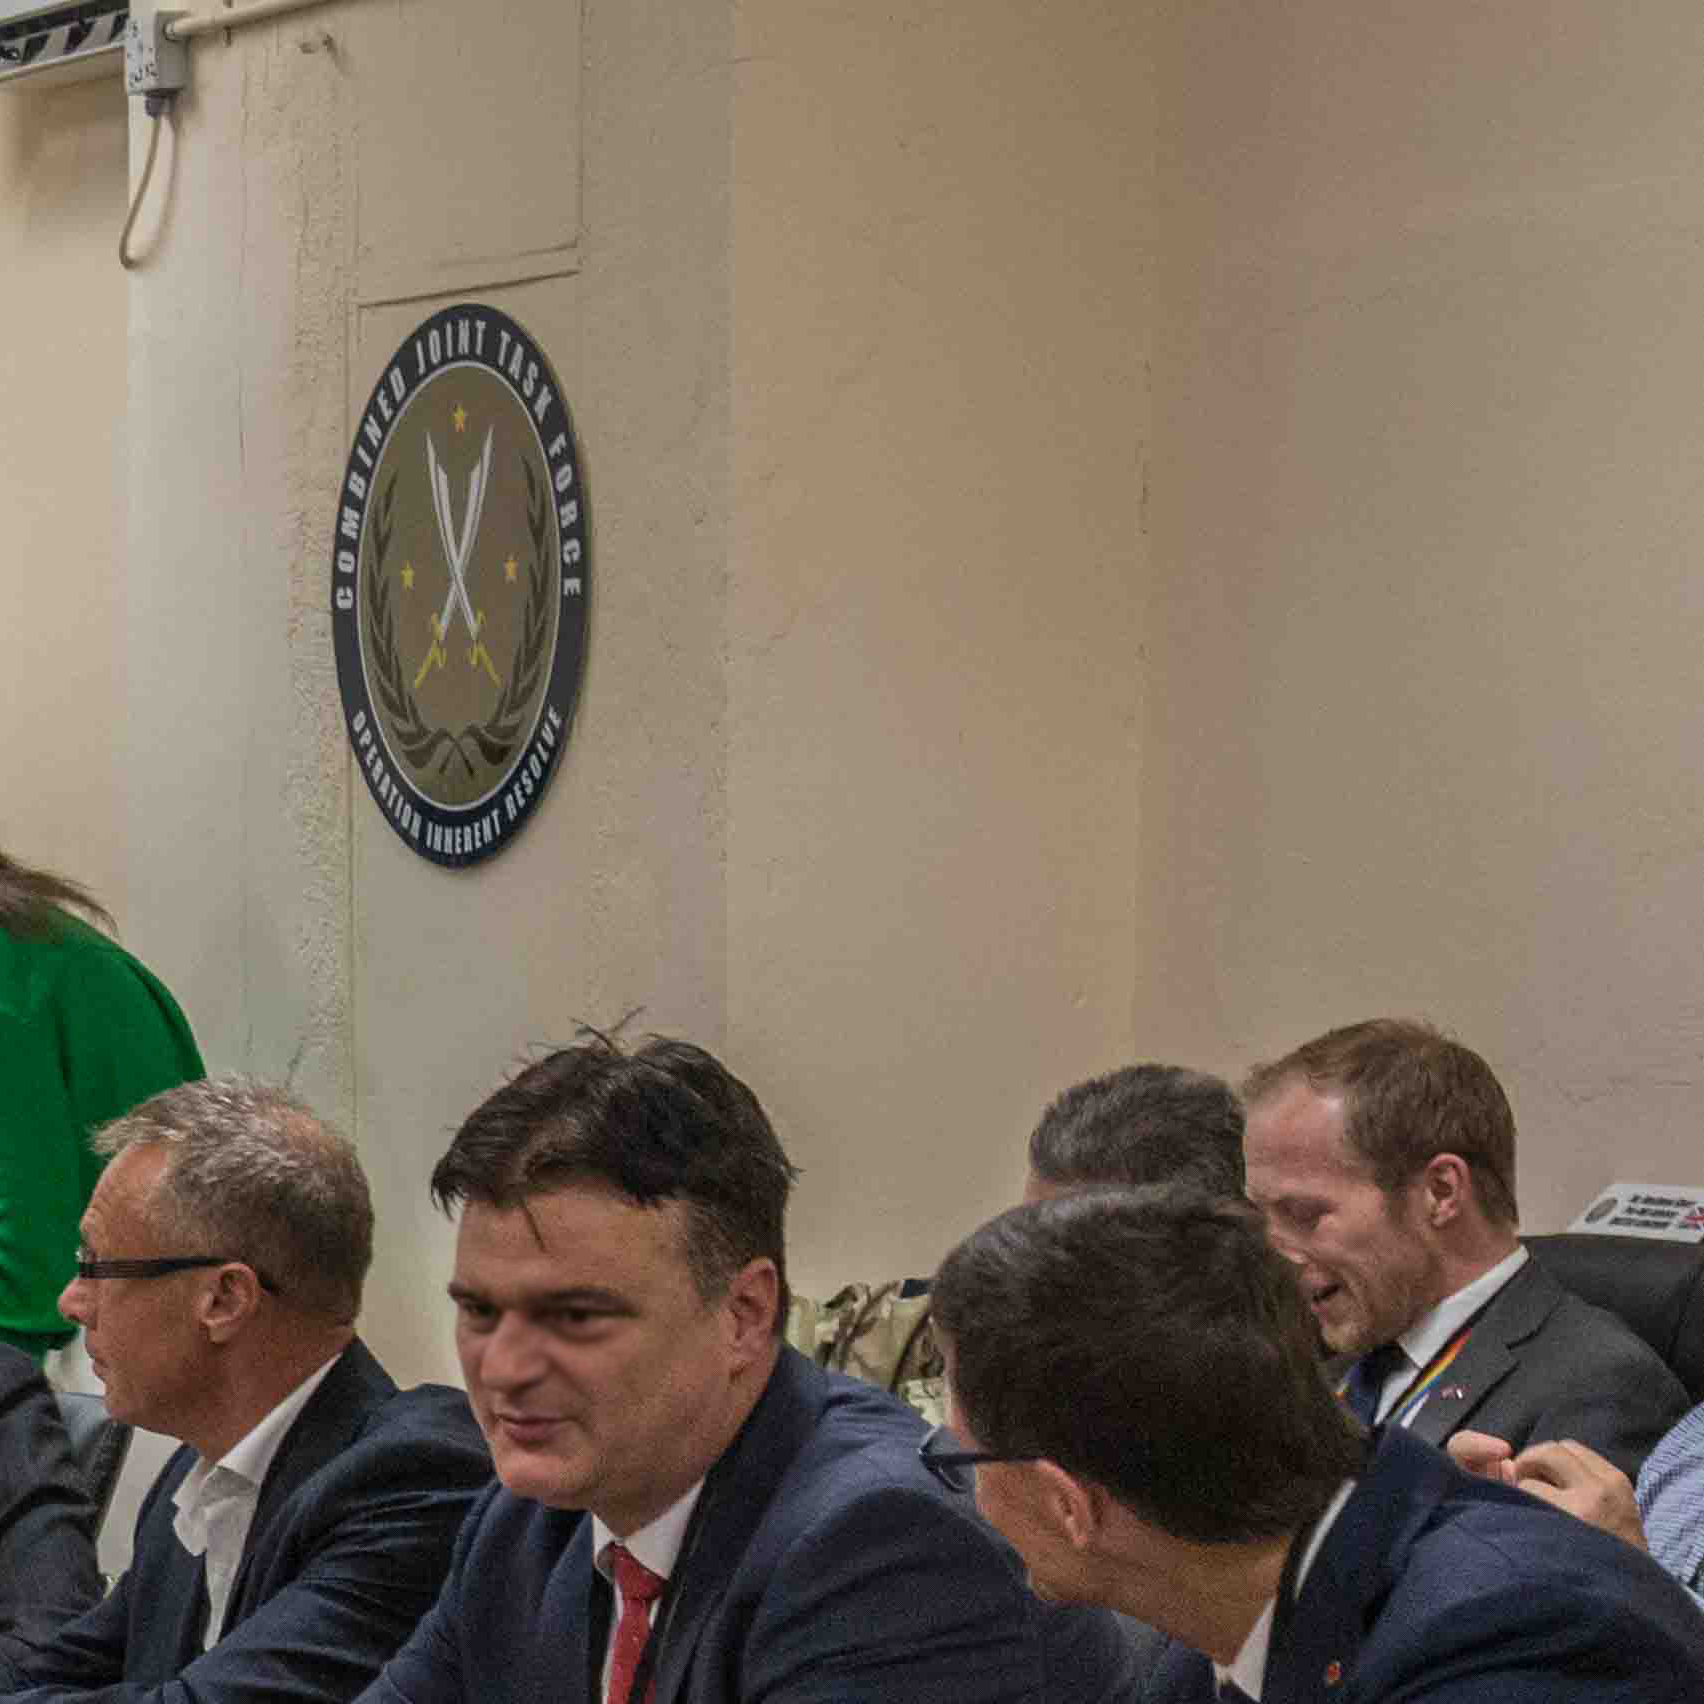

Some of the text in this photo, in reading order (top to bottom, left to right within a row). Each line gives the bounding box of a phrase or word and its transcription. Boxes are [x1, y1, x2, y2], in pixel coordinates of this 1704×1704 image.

[335, 319, 582, 609] COMBINED JOINT TASK FORCE
[351, 706, 563, 855] OPERATION INHERENT RESOLVE
